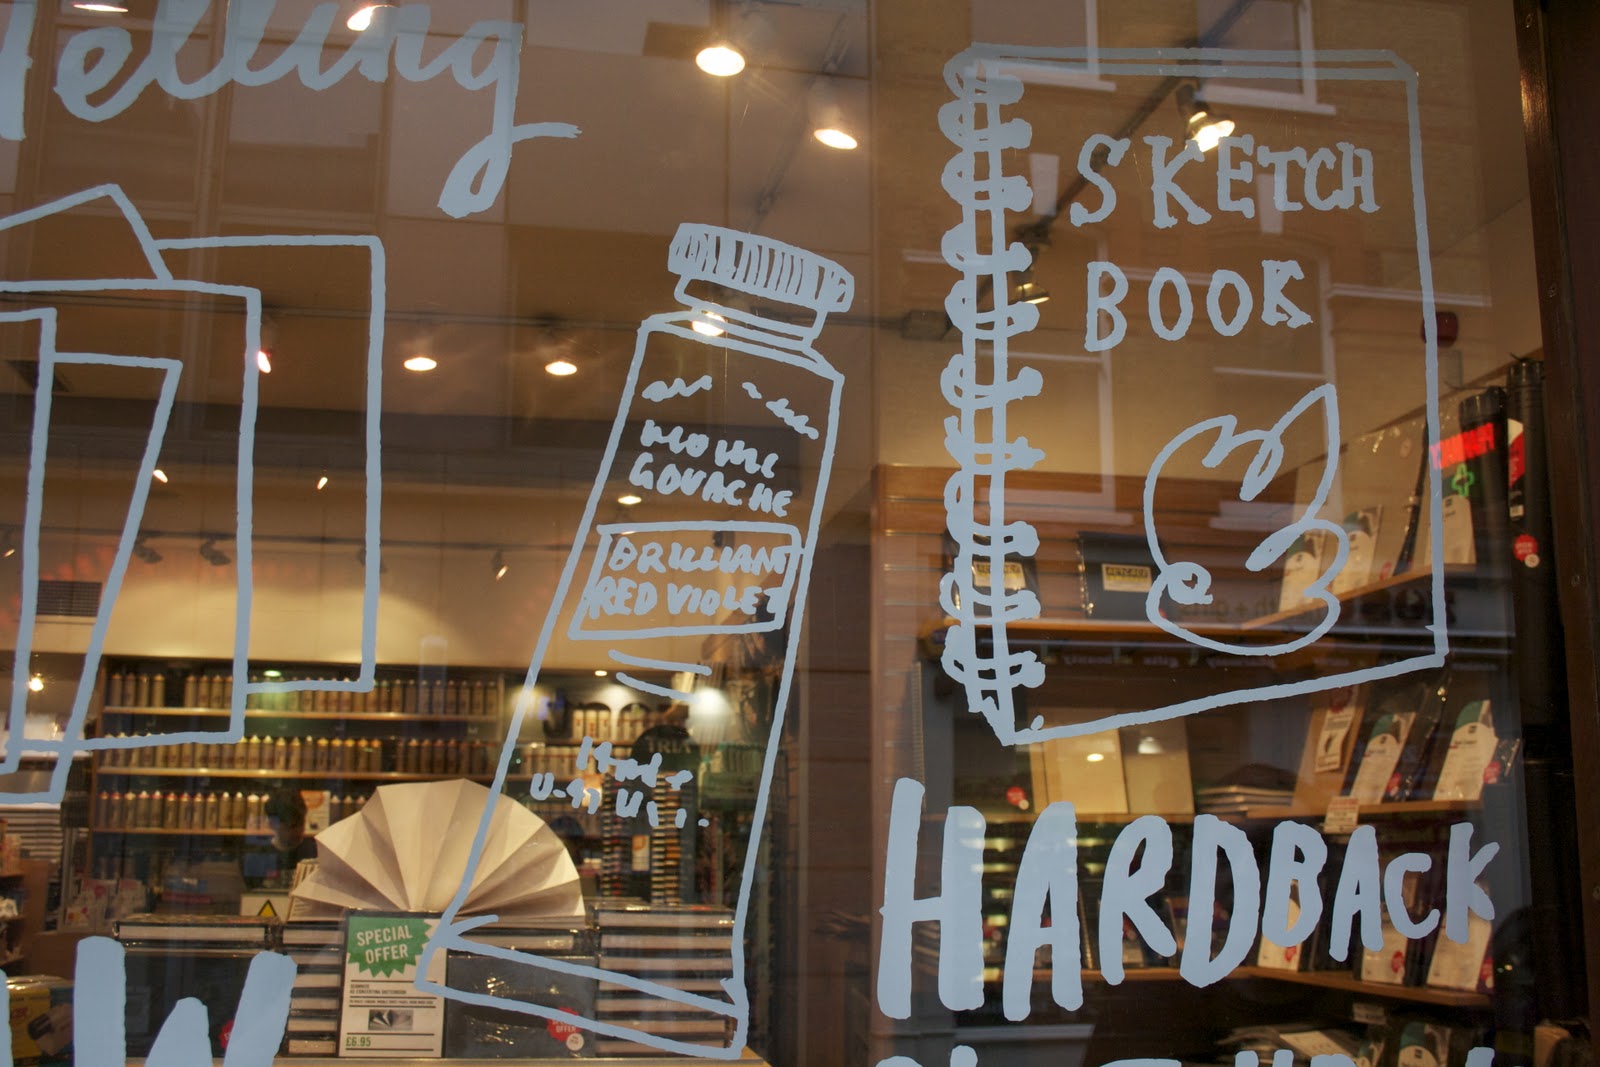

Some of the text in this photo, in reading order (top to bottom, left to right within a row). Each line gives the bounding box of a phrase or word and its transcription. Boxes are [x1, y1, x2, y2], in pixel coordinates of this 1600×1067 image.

[1070, 134, 1381, 229] SKETCH
[1084, 259, 1314, 352] BOOK
[588, 576, 786, 620] RED VIOLET
[876, 777, 1500, 1022] HARDBACK
[356, 924, 413, 947] SPECIAL
[365, 943, 409, 965] OFFER
[346, 1036, 371, 1047] £6.95
